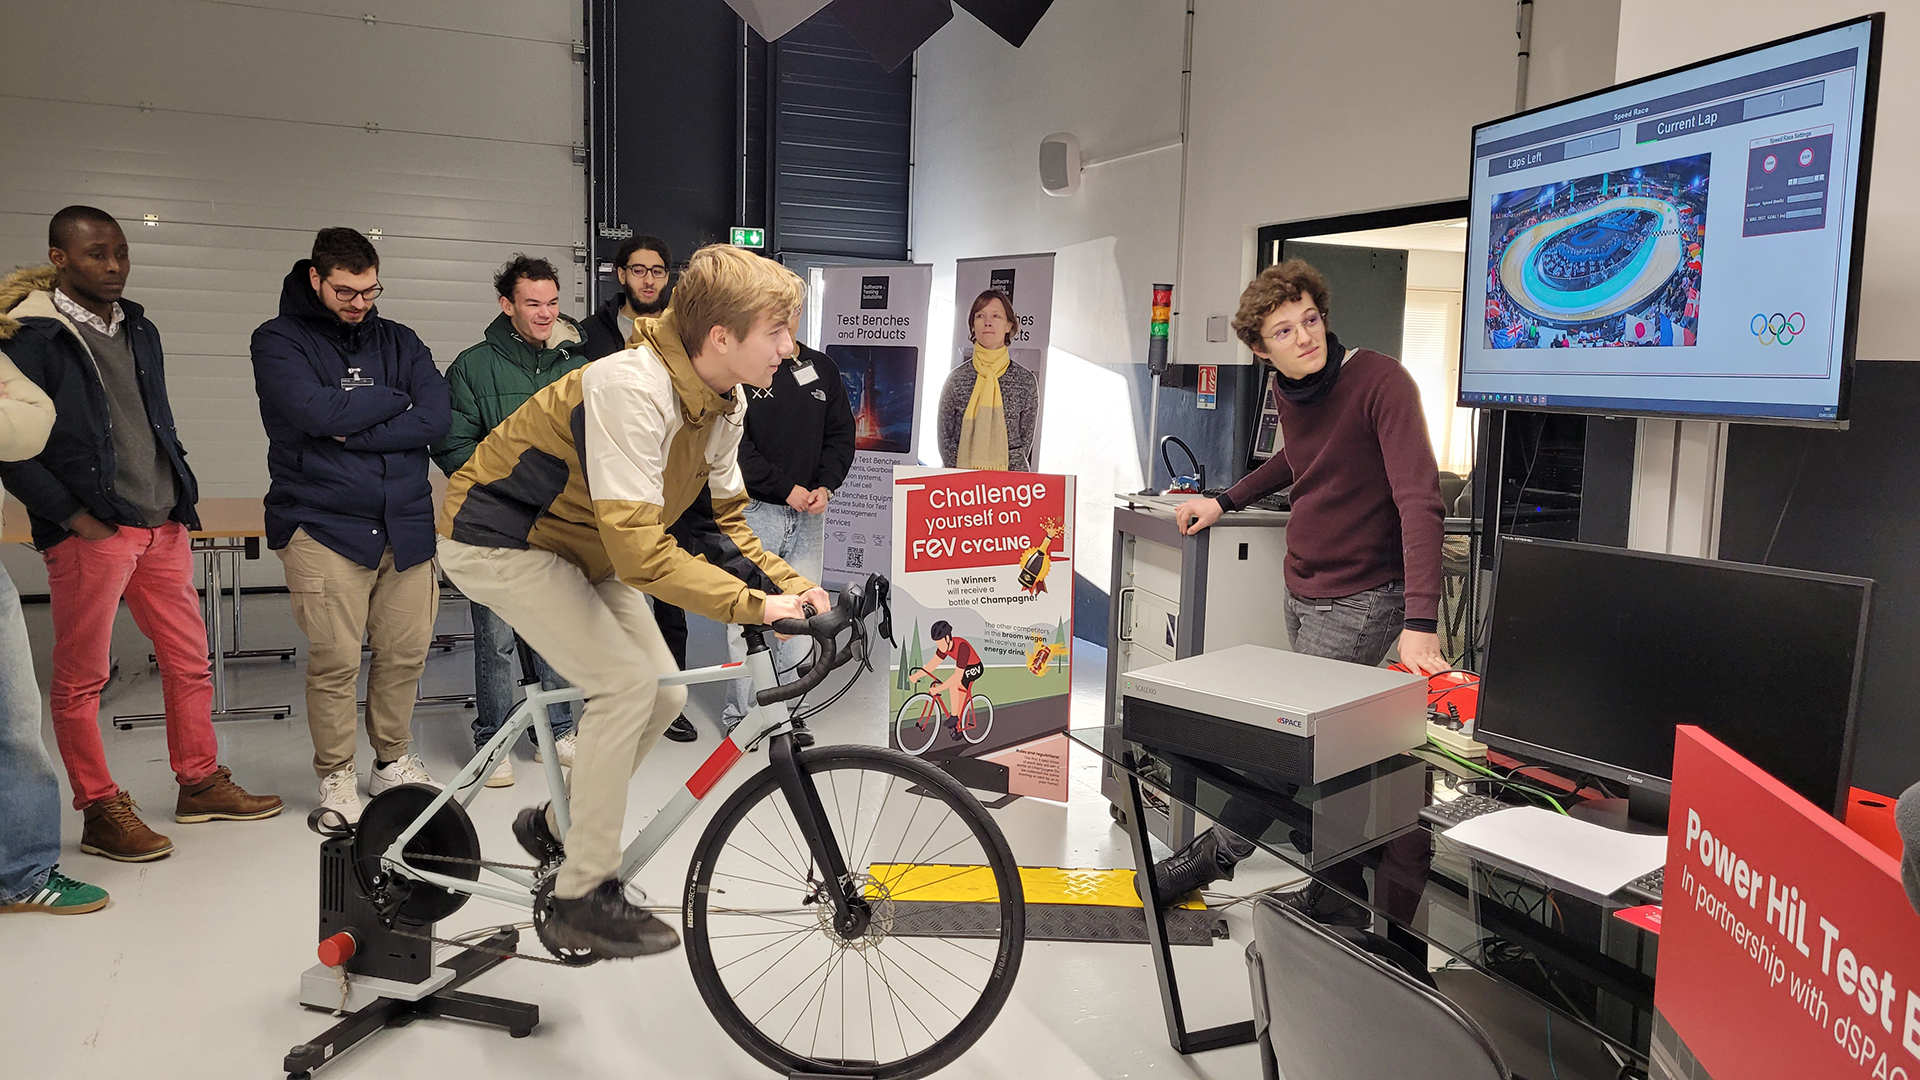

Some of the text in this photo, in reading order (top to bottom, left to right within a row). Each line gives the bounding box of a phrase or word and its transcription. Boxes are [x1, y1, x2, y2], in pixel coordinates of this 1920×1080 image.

[1780, 94, 1785, 107] 1
[1613, 106, 1649, 122] Speed Race
[1657, 112, 1718, 135] Current Lap
[1794, 131, 1812, 140] Settings
[1508, 152, 1542, 169] Laps Left
[837, 314, 910, 326] Test Benches
[838, 328, 906, 339] and Products
[859, 456, 872, 464] Test
[842, 491, 868, 500] Benches
[929, 482, 1046, 509] Challenge
[841, 508, 877, 517] Management
[826, 517, 851, 526] Services
[925, 509, 1021, 535] yourself on
[961, 535, 1031, 554] CYCLING
[961, 576, 996, 584] Winners
[980, 594, 1038, 605] Champagne!
[1013, 626, 1050, 635] competitors
[995, 639, 1016, 647] receive
[1002, 632, 1024, 640] broom
[1025, 635, 1047, 643] wagon
[984, 646, 1025, 656] energy drink
[1135, 684, 1157, 696] SCALEXIO
[1277, 717, 1302, 729] dSPACE
[1686, 807, 1762, 909] Power
[1766, 874, 1810, 958] HiL
[1819, 916, 1896, 1034] Test
[1682, 864, 1694, 896] In
[1695, 883, 1785, 987] partnership
[1790, 971, 1829, 1029] with
[994, 950, 1007, 979] TRIBAN
